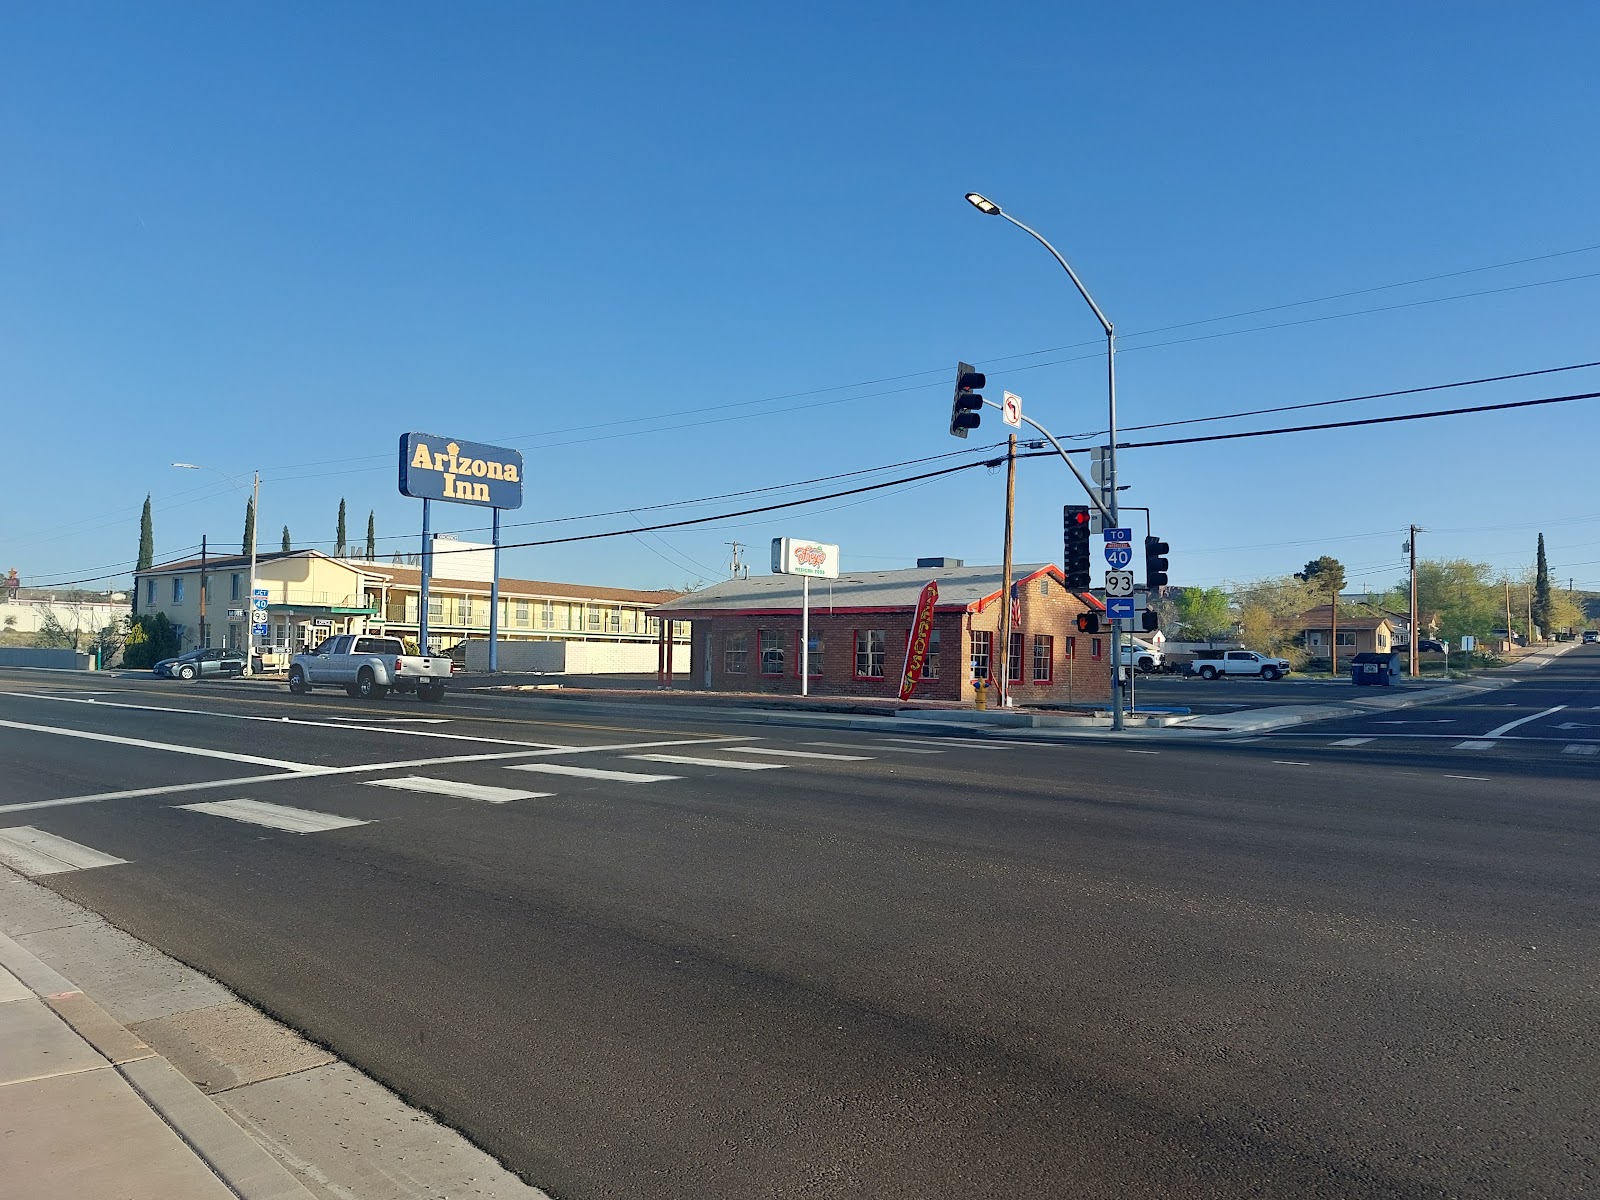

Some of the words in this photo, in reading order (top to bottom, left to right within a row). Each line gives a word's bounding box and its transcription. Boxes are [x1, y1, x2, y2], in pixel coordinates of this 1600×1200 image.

[411, 442, 519, 483] Arizona
[443, 473, 490, 502] Inn
[1110, 531, 1124, 539] TO
[1108, 551, 1128, 564] 40
[1108, 576, 1131, 591] 93
[254, 612, 266, 621] 93
